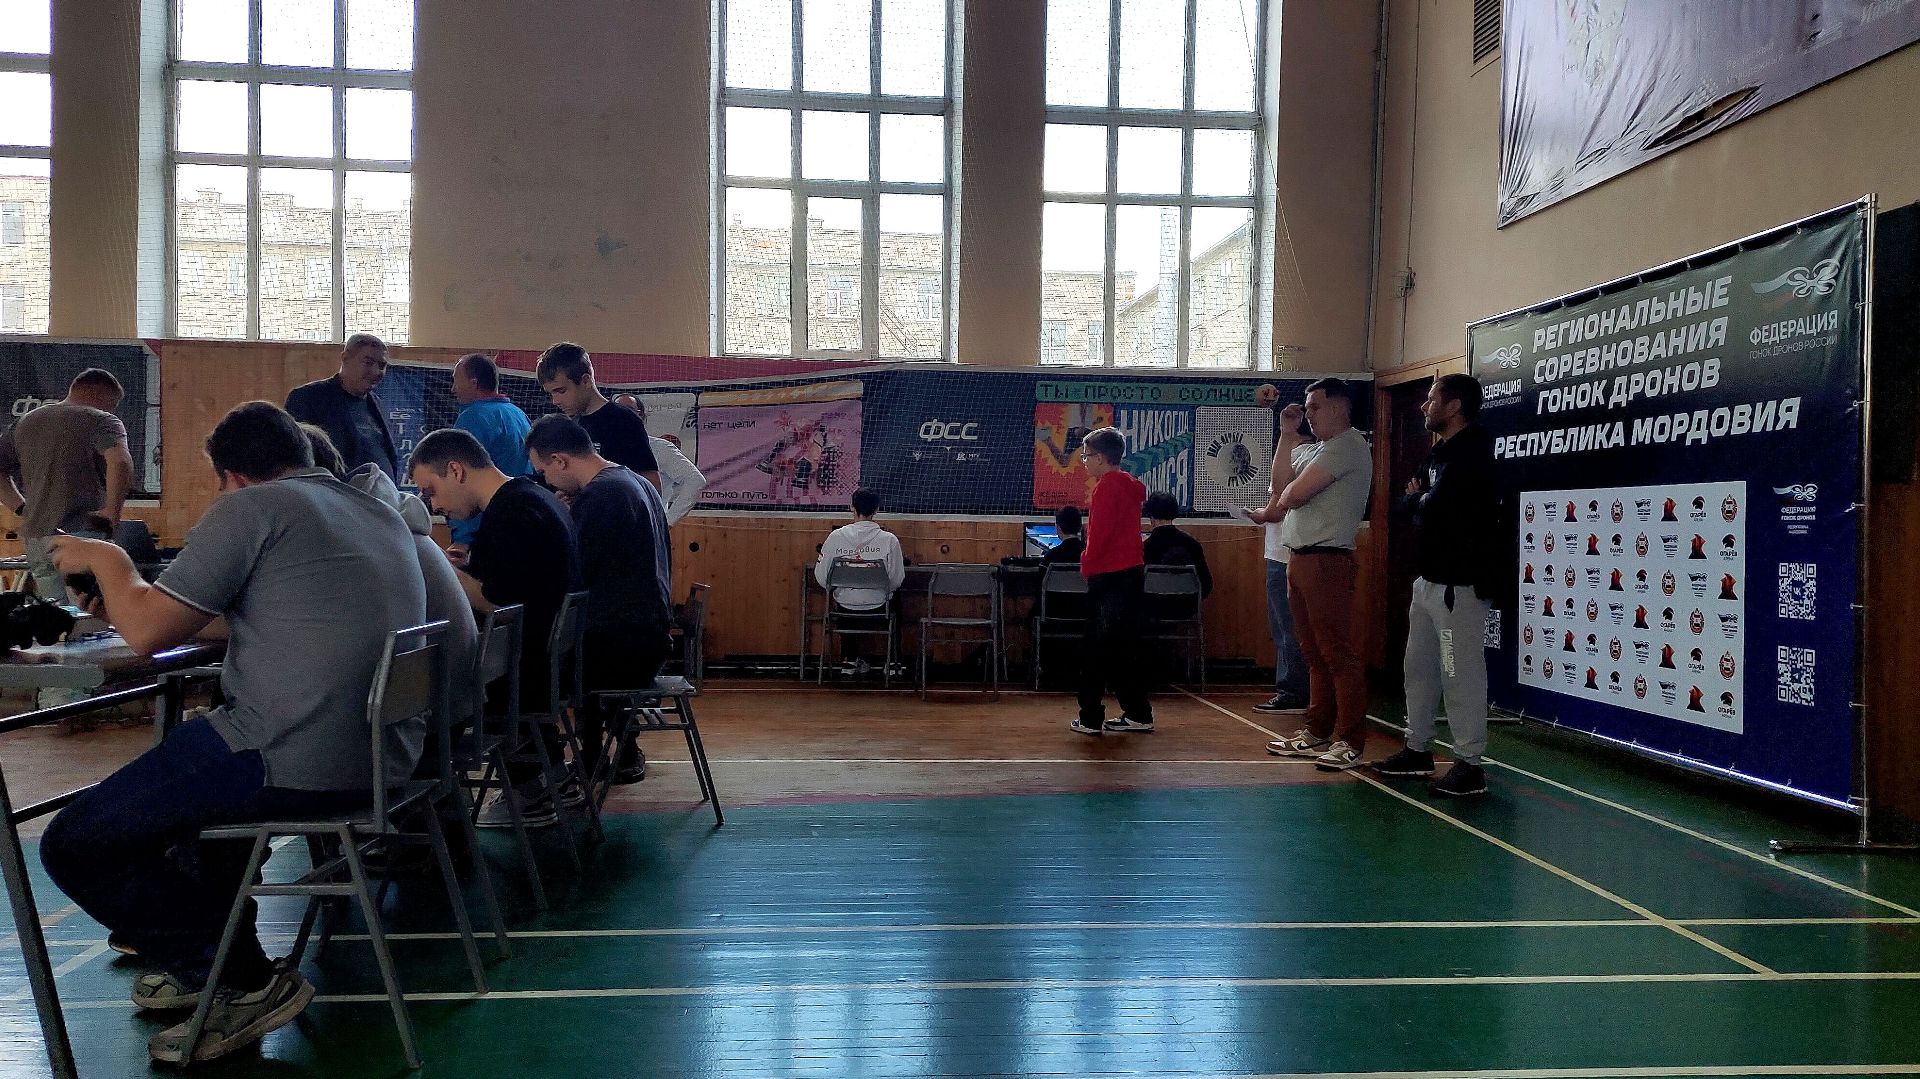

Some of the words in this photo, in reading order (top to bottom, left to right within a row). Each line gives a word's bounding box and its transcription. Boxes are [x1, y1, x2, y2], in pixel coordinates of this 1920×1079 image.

[1532, 276, 1732, 353] РЕГИОНАЛЬНЫЕ
[1749, 309, 1838, 345] ФЕДЕРАЦИЯ
[1533, 316, 1728, 384] СОРЕВНОВАНИЯ
[1040, 383, 1070, 399] ТЫ
[1084, 385, 1162, 401] ПРОСТО
[1179, 386, 1256, 403] СОЛНЦЕ
[1537, 379, 1607, 415] ГОНОК
[1608, 358, 1721, 409] ДРОНОВ
[919, 418, 978, 442] ФСС
[1119, 409, 1189, 454] НИКОГДА
[1494, 421, 1625, 460] РЕСПУБЛИКА
[1631, 396, 1801, 446] МОРДОВИЯ
